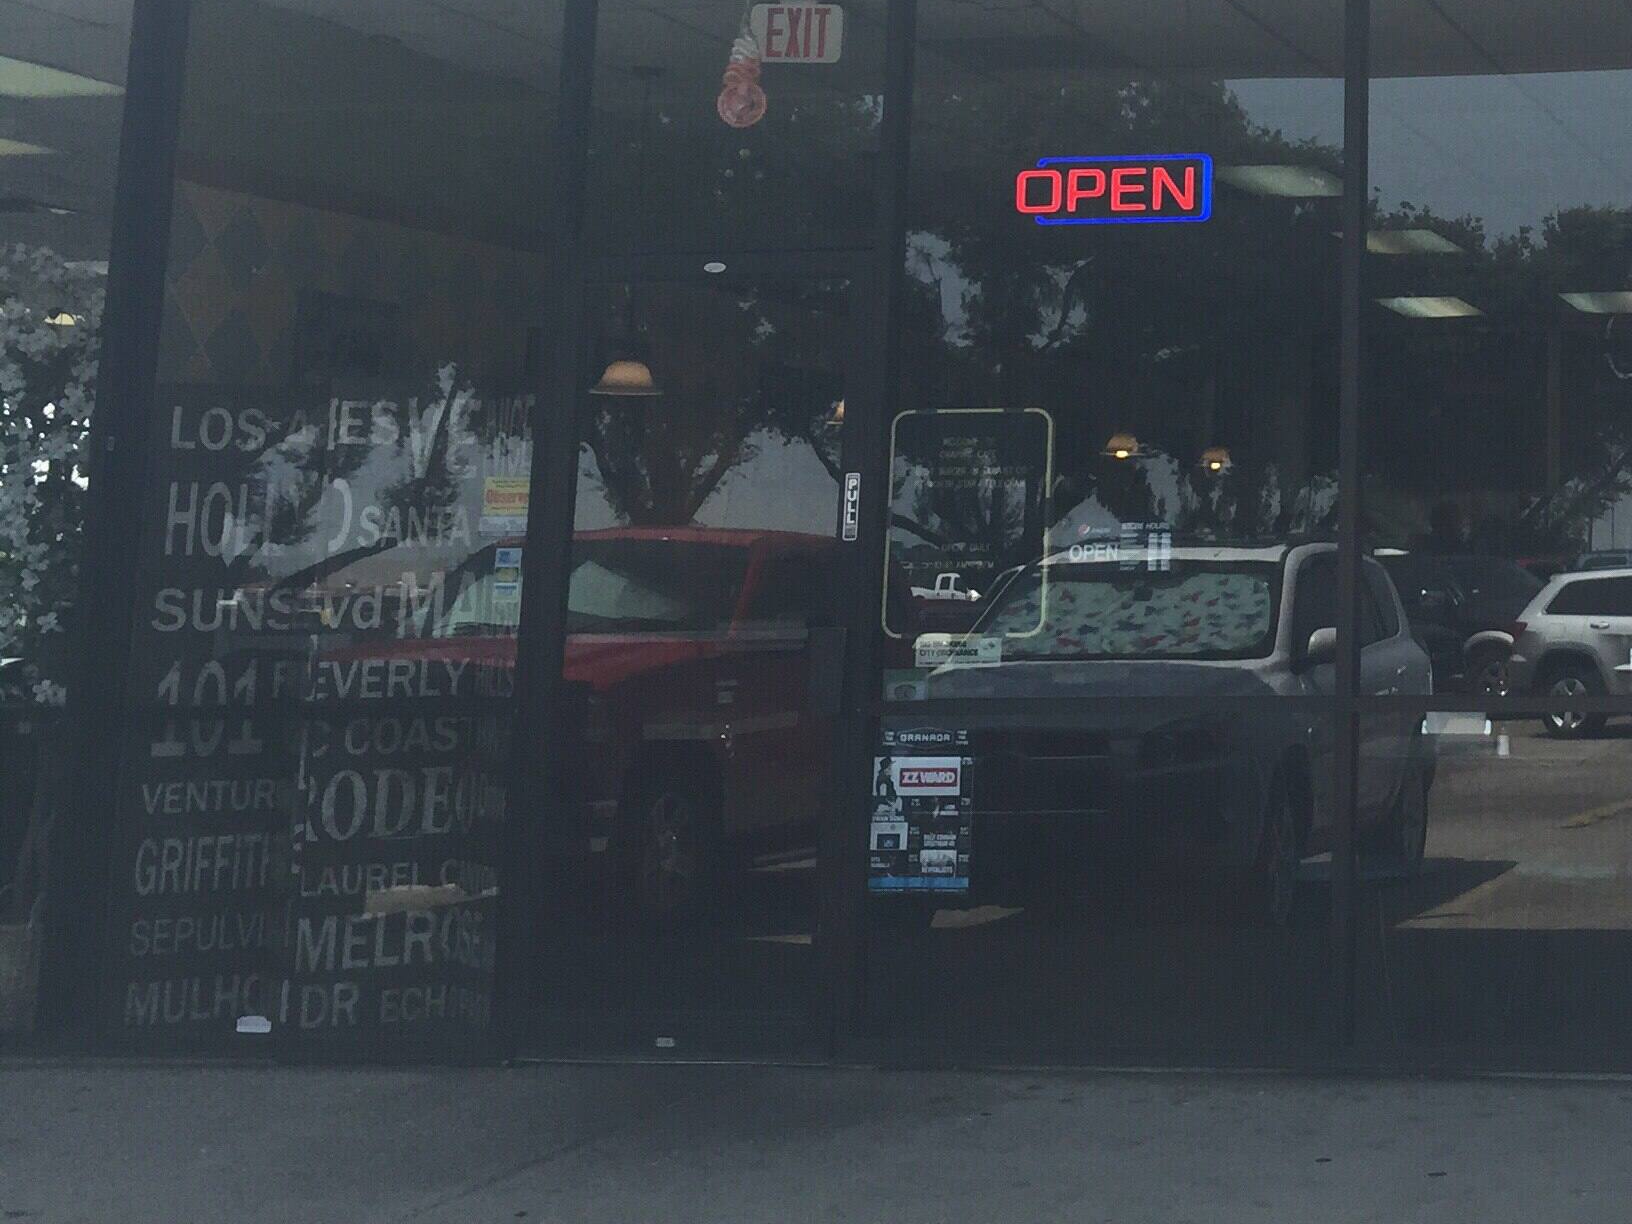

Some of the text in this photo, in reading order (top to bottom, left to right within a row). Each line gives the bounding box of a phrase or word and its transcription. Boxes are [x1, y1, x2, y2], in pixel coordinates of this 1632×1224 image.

[766, 7, 831, 58] EXIT
[1016, 166, 1194, 213] OPEN
[170, 405, 266, 452] LOS
[846, 478, 858, 523] PULL
[1069, 543, 1118, 561] OPEN
[151, 587, 292, 633] SUNS
[142, 777, 277, 815] VENTUR
[902, 772, 955, 783] ZZ WARD
